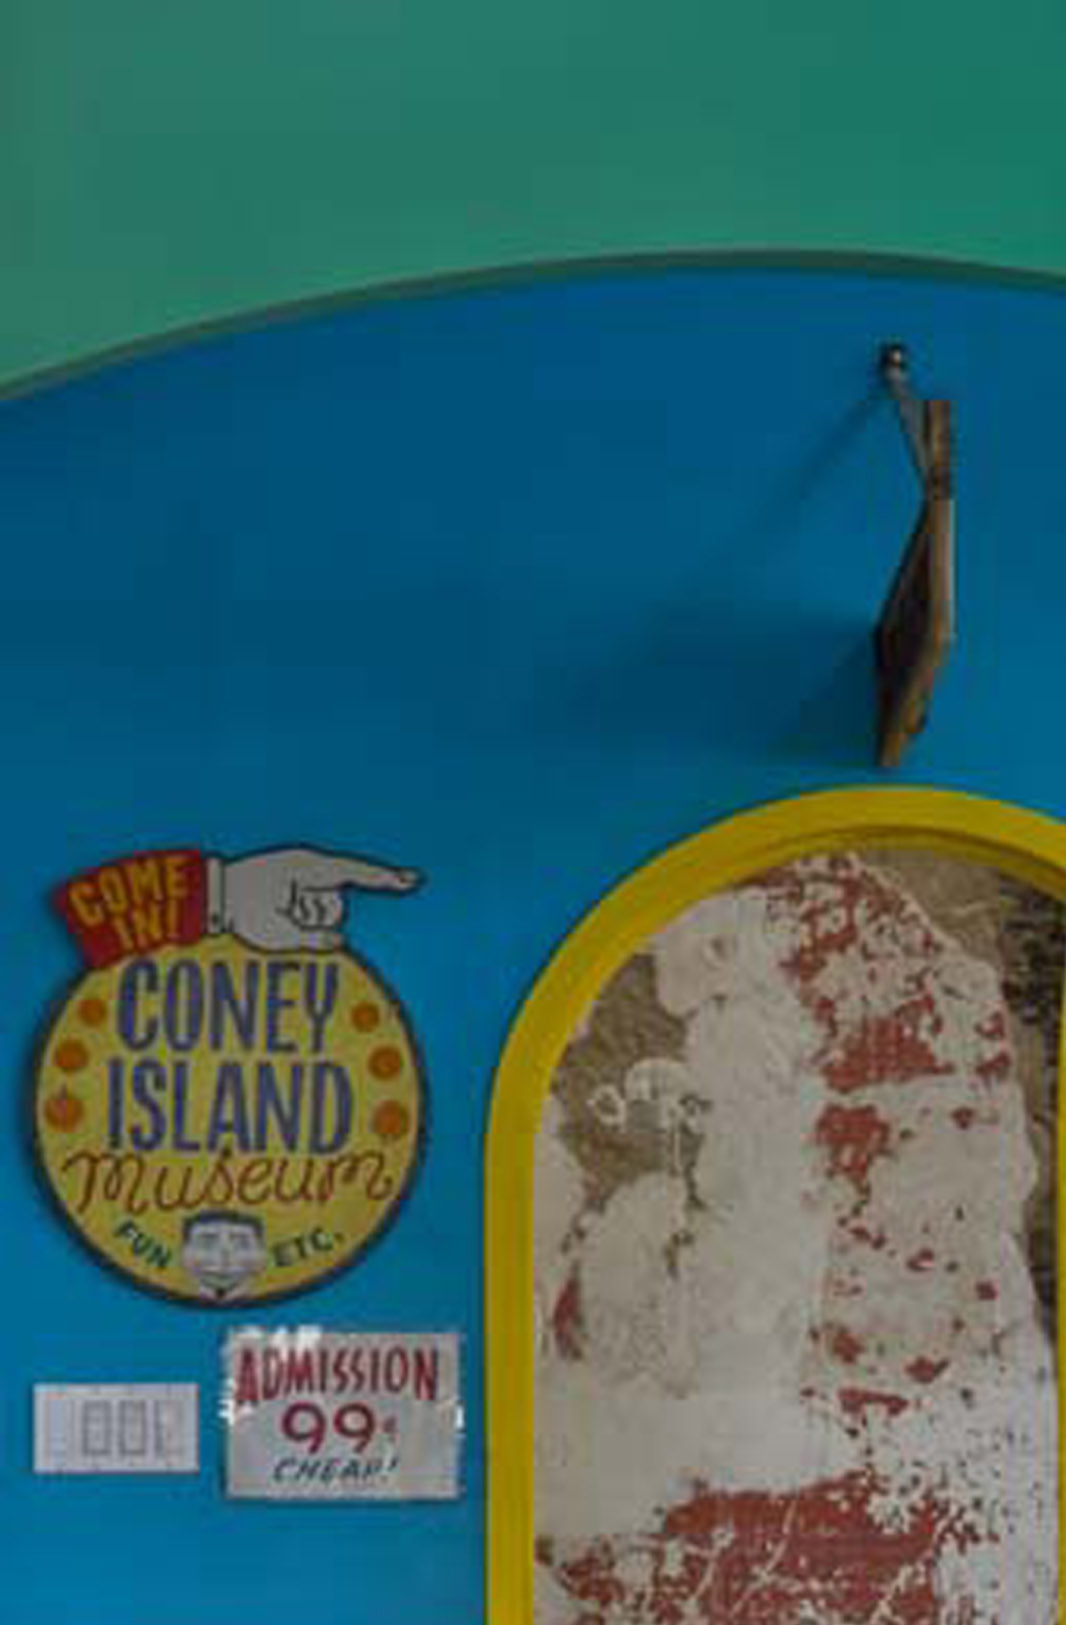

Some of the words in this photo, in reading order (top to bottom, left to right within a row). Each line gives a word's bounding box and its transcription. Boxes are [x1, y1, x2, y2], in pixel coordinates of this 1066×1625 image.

[70, 855, 190, 927] COME
[113, 902, 180, 952] IN!
[117, 959, 340, 1052] CONEY
[107, 1058, 353, 1155] ISLAND
[115, 1222, 174, 1268] FUN
[273, 1227, 346, 1268] ETC.
[235, 1347, 440, 1404] ADMISSION
[273, 1456, 399, 1484] CHEAP!
